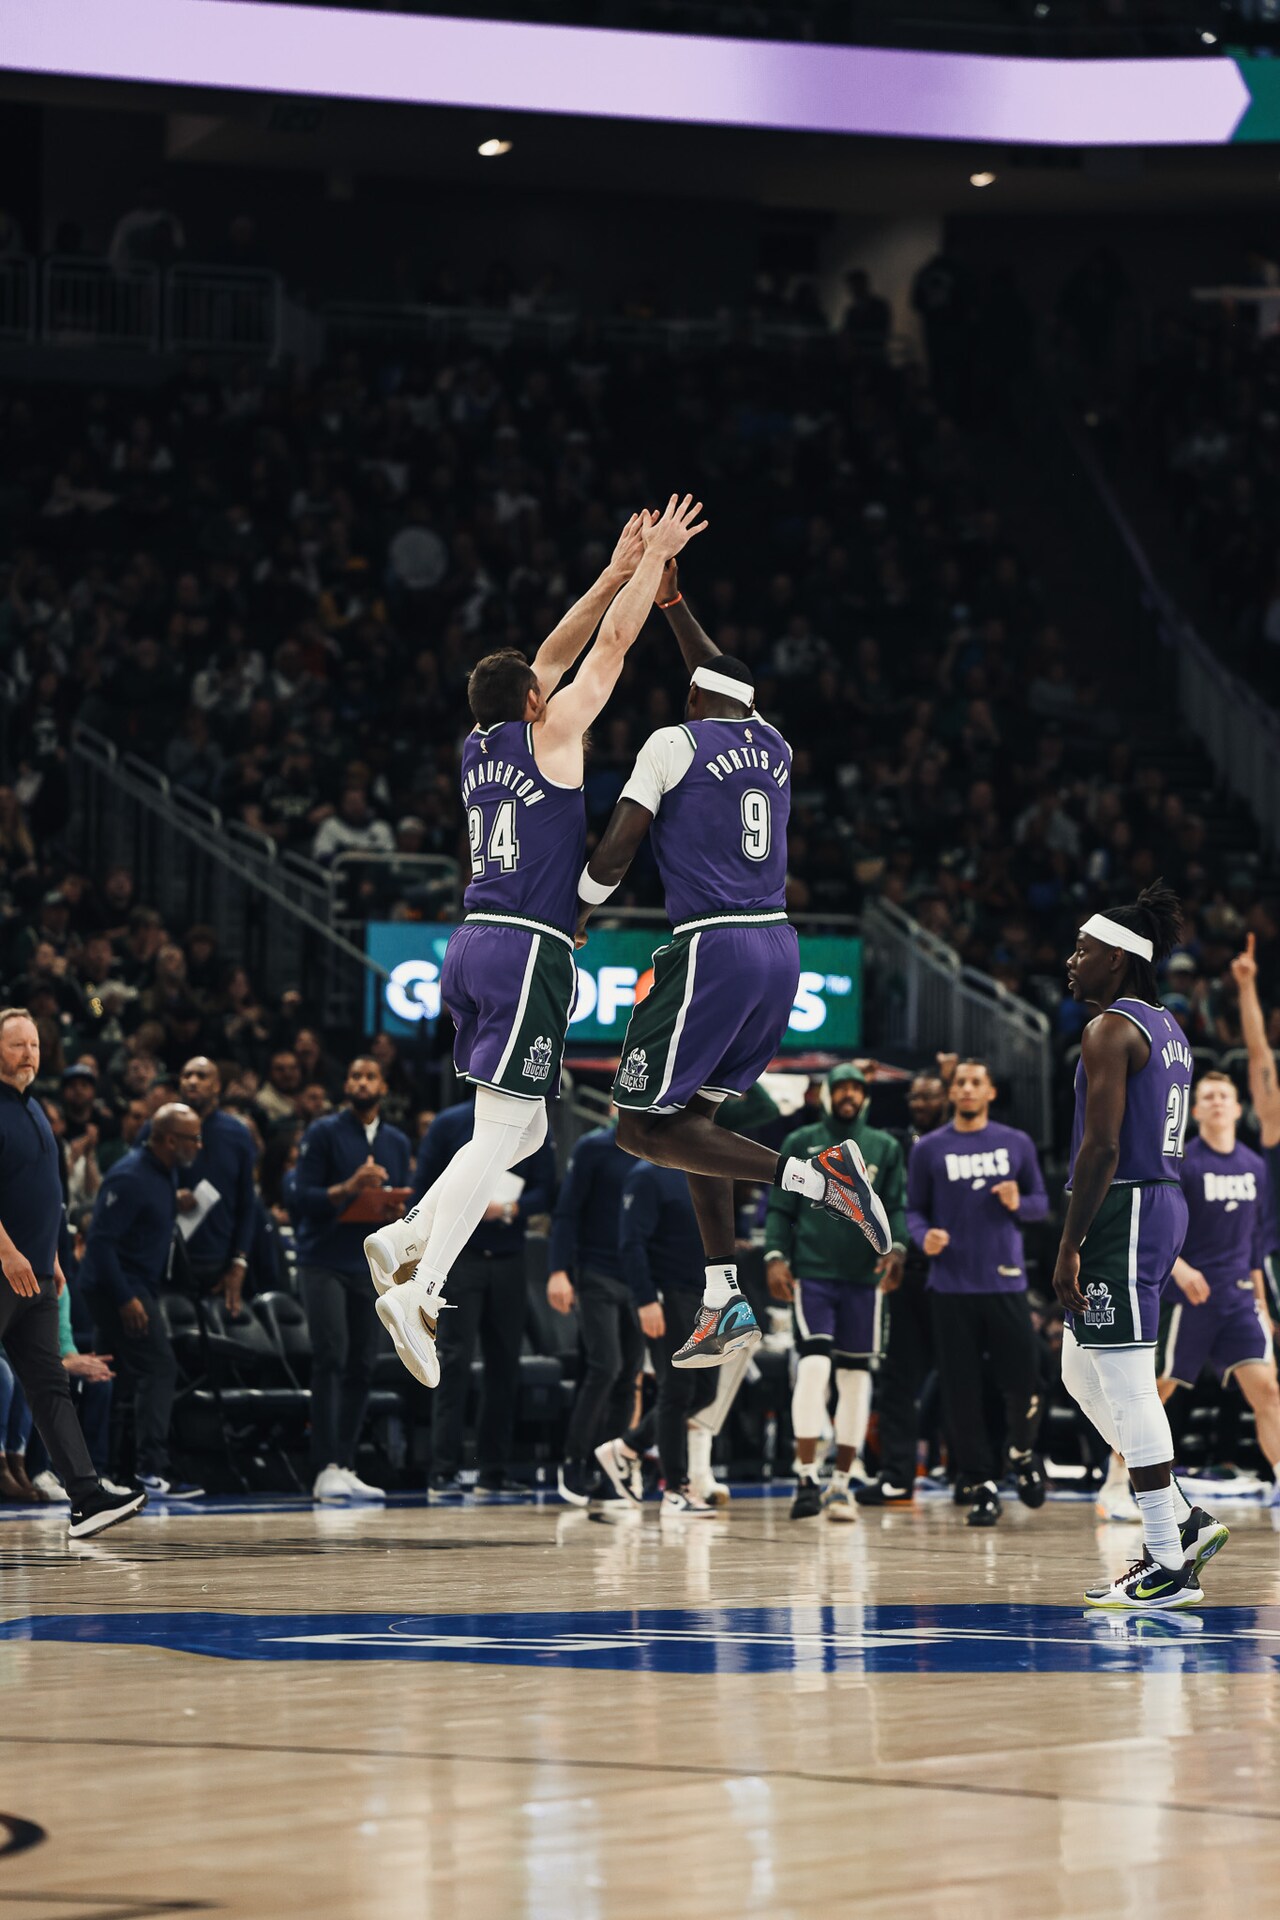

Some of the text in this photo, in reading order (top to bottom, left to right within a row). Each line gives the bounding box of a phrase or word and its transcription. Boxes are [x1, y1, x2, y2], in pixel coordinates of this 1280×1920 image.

[462, 760, 546, 807] NNAUGHTON
[706, 748, 788, 788] PORTIS JR
[467, 799, 520, 879] 24
[740, 788, 772, 862] 9
[525, 1063, 550, 1078] BUCKS
[620, 1074, 644, 1089] BUCKS
[1162, 1083, 1190, 1157] 21
[945, 1148, 1010, 1181] BUCKS
[1203, 1172, 1257, 1202] BUCKS
[1086, 1310, 1112, 1323] BUCKS
